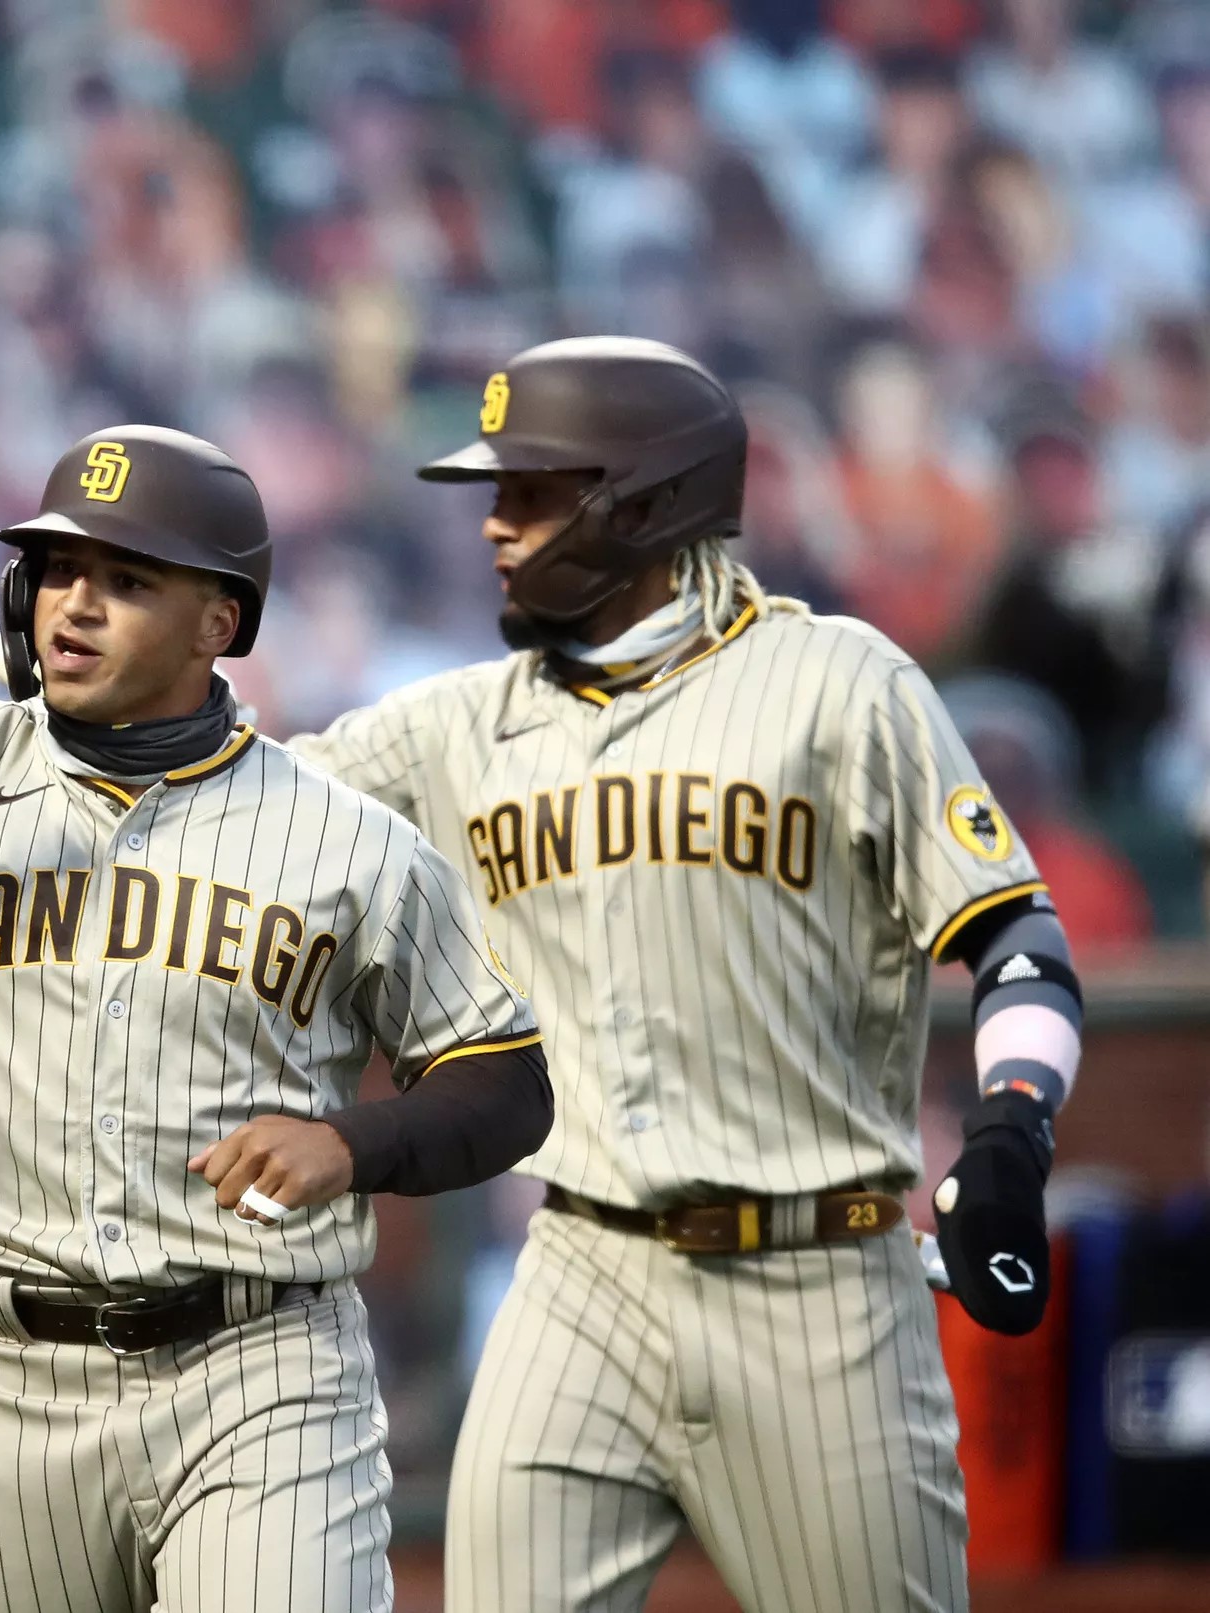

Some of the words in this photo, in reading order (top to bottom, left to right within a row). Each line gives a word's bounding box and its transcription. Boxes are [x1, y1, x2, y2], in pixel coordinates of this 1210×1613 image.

[80, 441, 131, 503] SD
[467, 788, 578, 906] SAN
[595, 770, 817, 894] DIEGO
[101, 862, 338, 1030] DIEGO
[846, 1202, 878, 1229] 23
